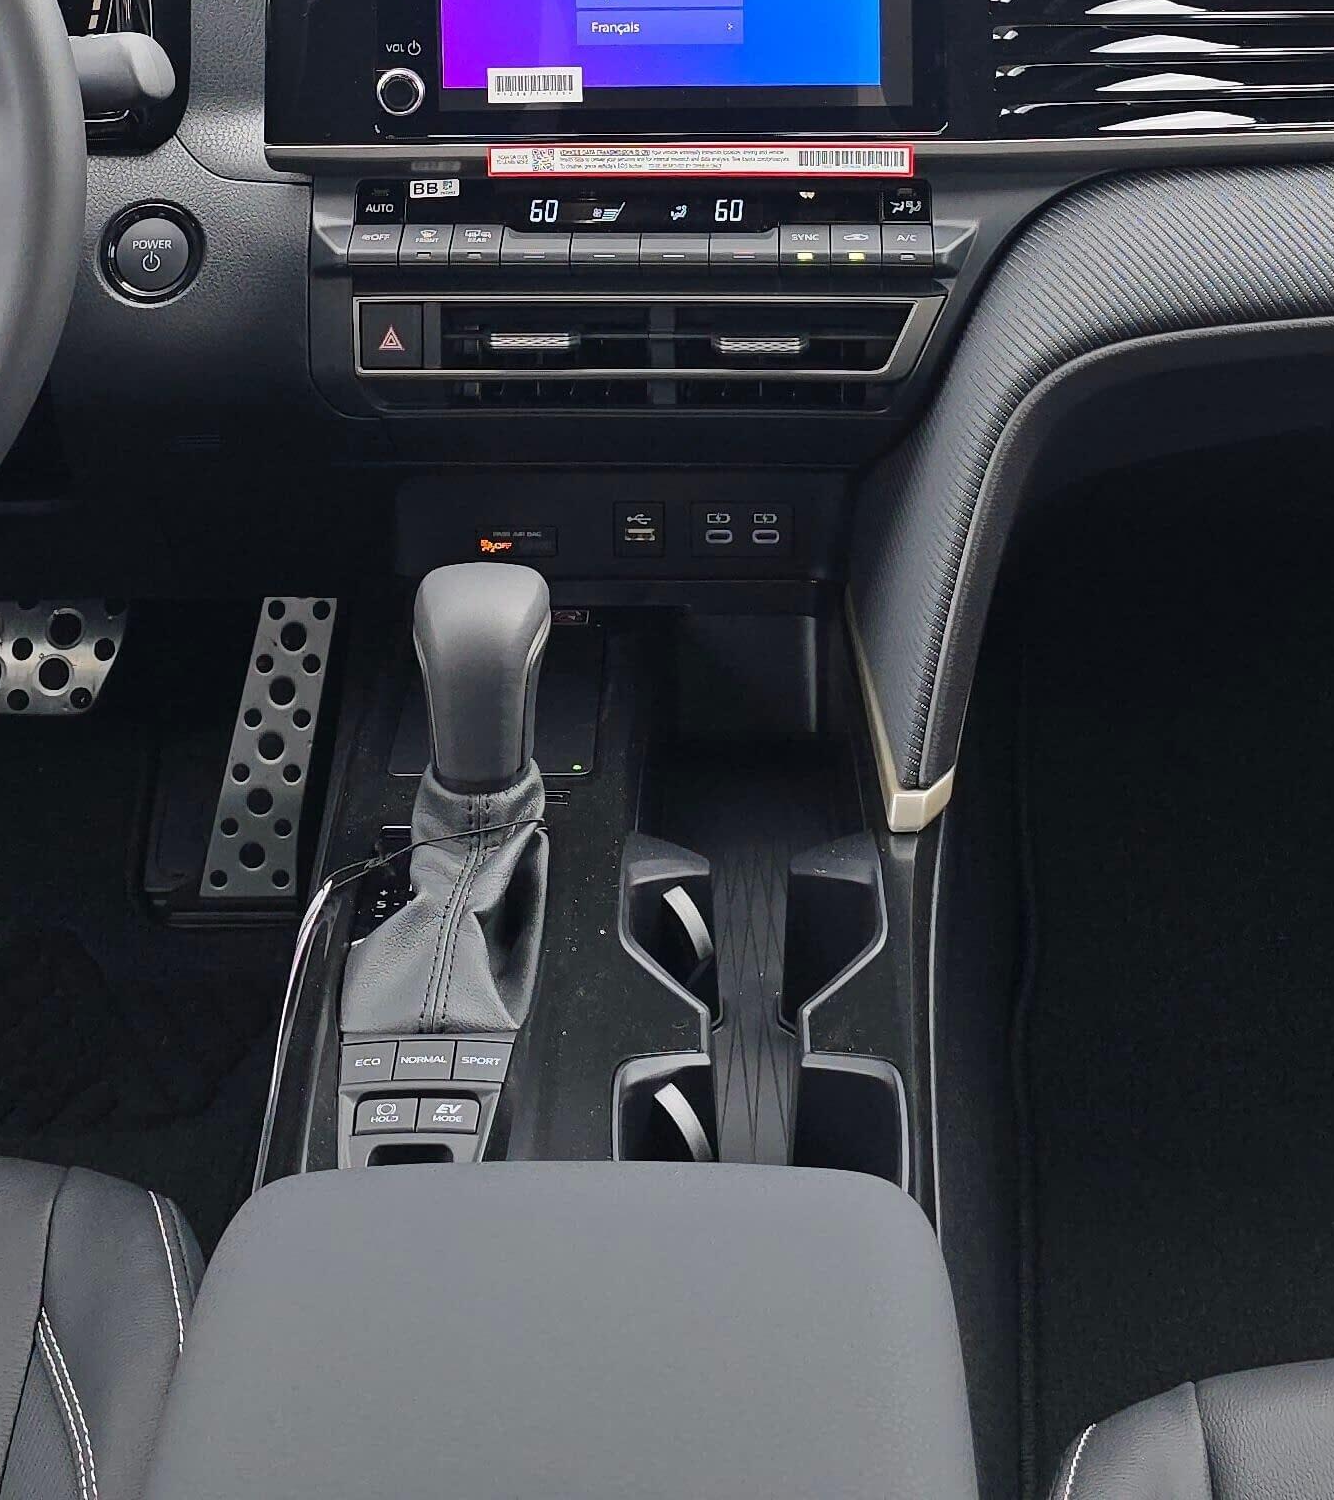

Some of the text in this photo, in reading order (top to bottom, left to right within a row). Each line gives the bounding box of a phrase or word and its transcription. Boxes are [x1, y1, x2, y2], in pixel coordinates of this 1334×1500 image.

[591, 21, 640, 35] Français
[385, 43, 405, 53] VOL
[365, 203, 394, 213] AUTO
[529, 199, 559, 223] 60
[714, 199, 744, 222] 60
[791, 233, 820, 241] SYNC
[896, 234, 917, 242] A/C
[132, 239, 172, 250] POWER
[376, 900, 386, 908] S
[355, 1057, 380, 1067] ECO
[400, 1054, 447, 1064] NORMAL
[461, 1056, 501, 1066] SPORT
[435, 1103, 463, 1114] EV
[370, 1114, 399, 1123] HOLD
[432, 1114, 463, 1123] MODE
